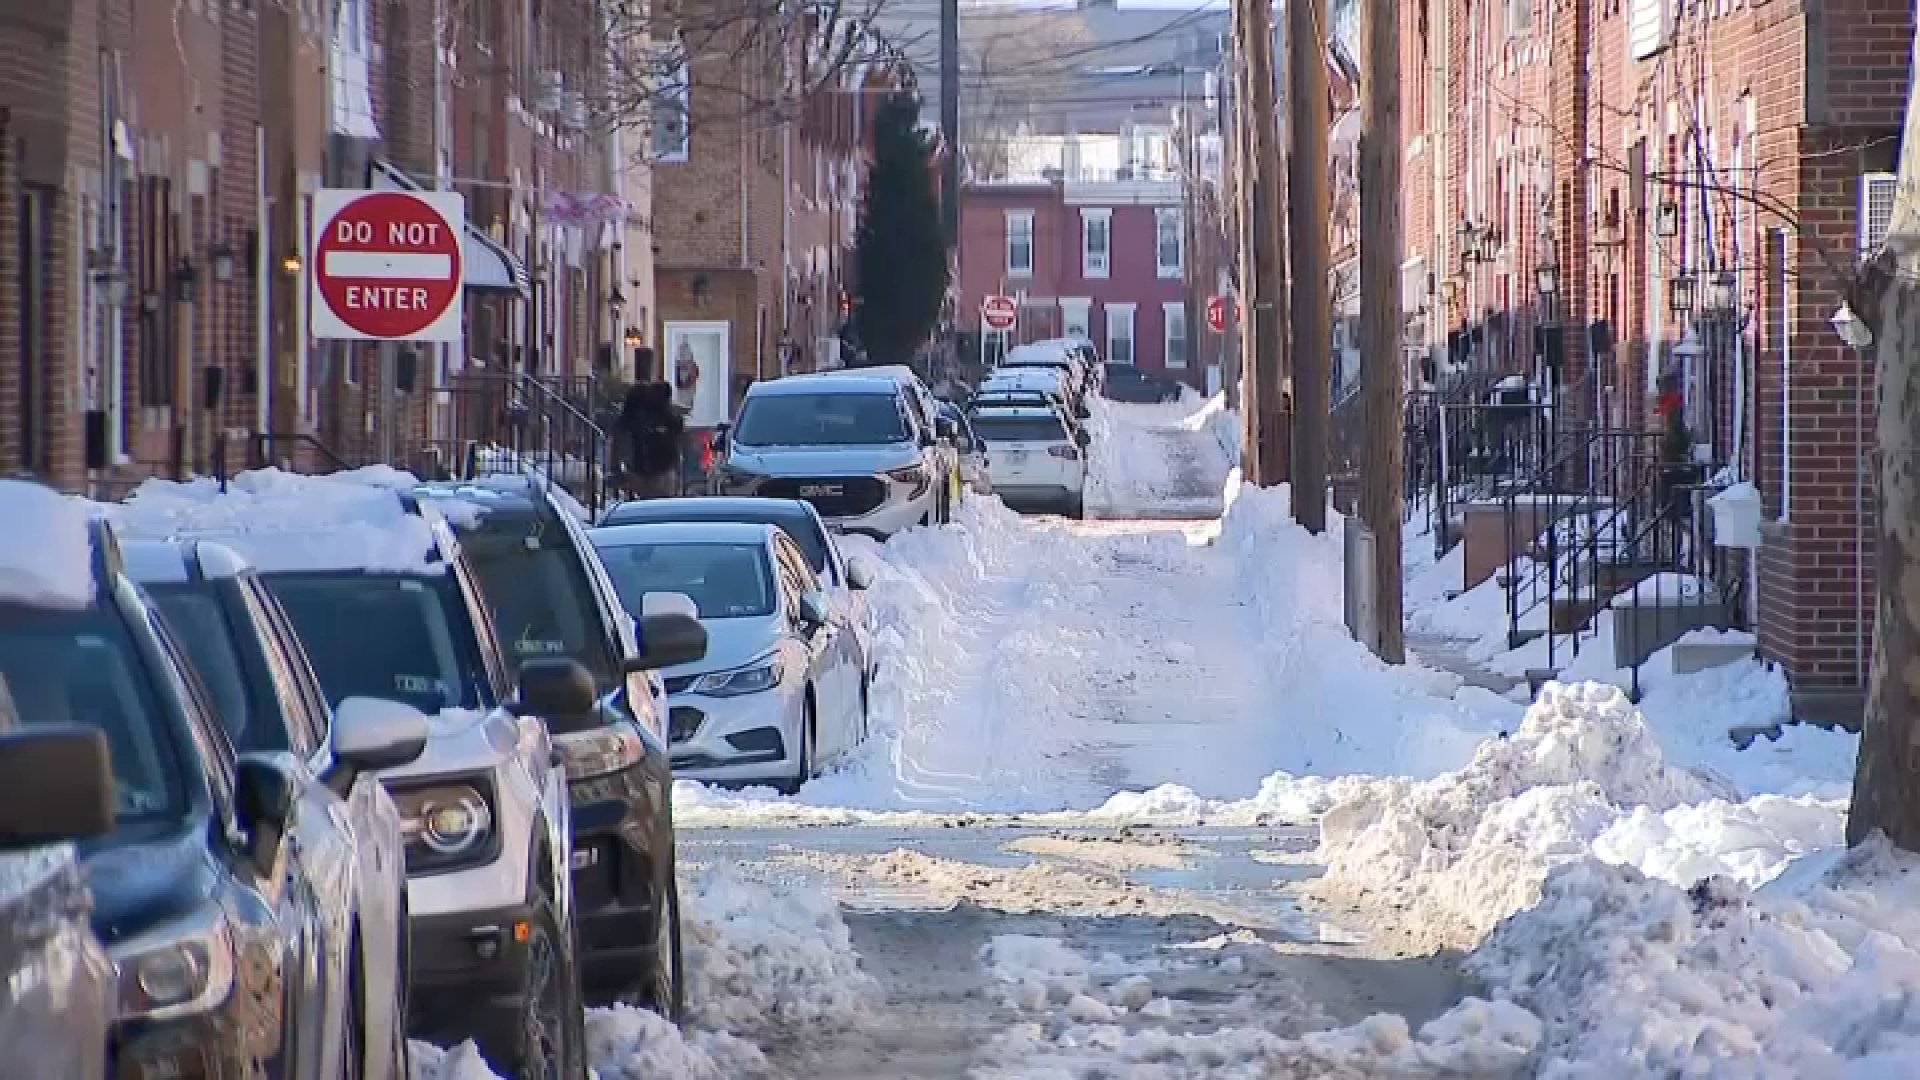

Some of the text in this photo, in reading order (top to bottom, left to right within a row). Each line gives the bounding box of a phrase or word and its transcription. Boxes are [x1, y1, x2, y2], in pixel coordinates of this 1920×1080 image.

[338, 221, 439, 245] DO NOT
[346, 286, 428, 310] ENTER
